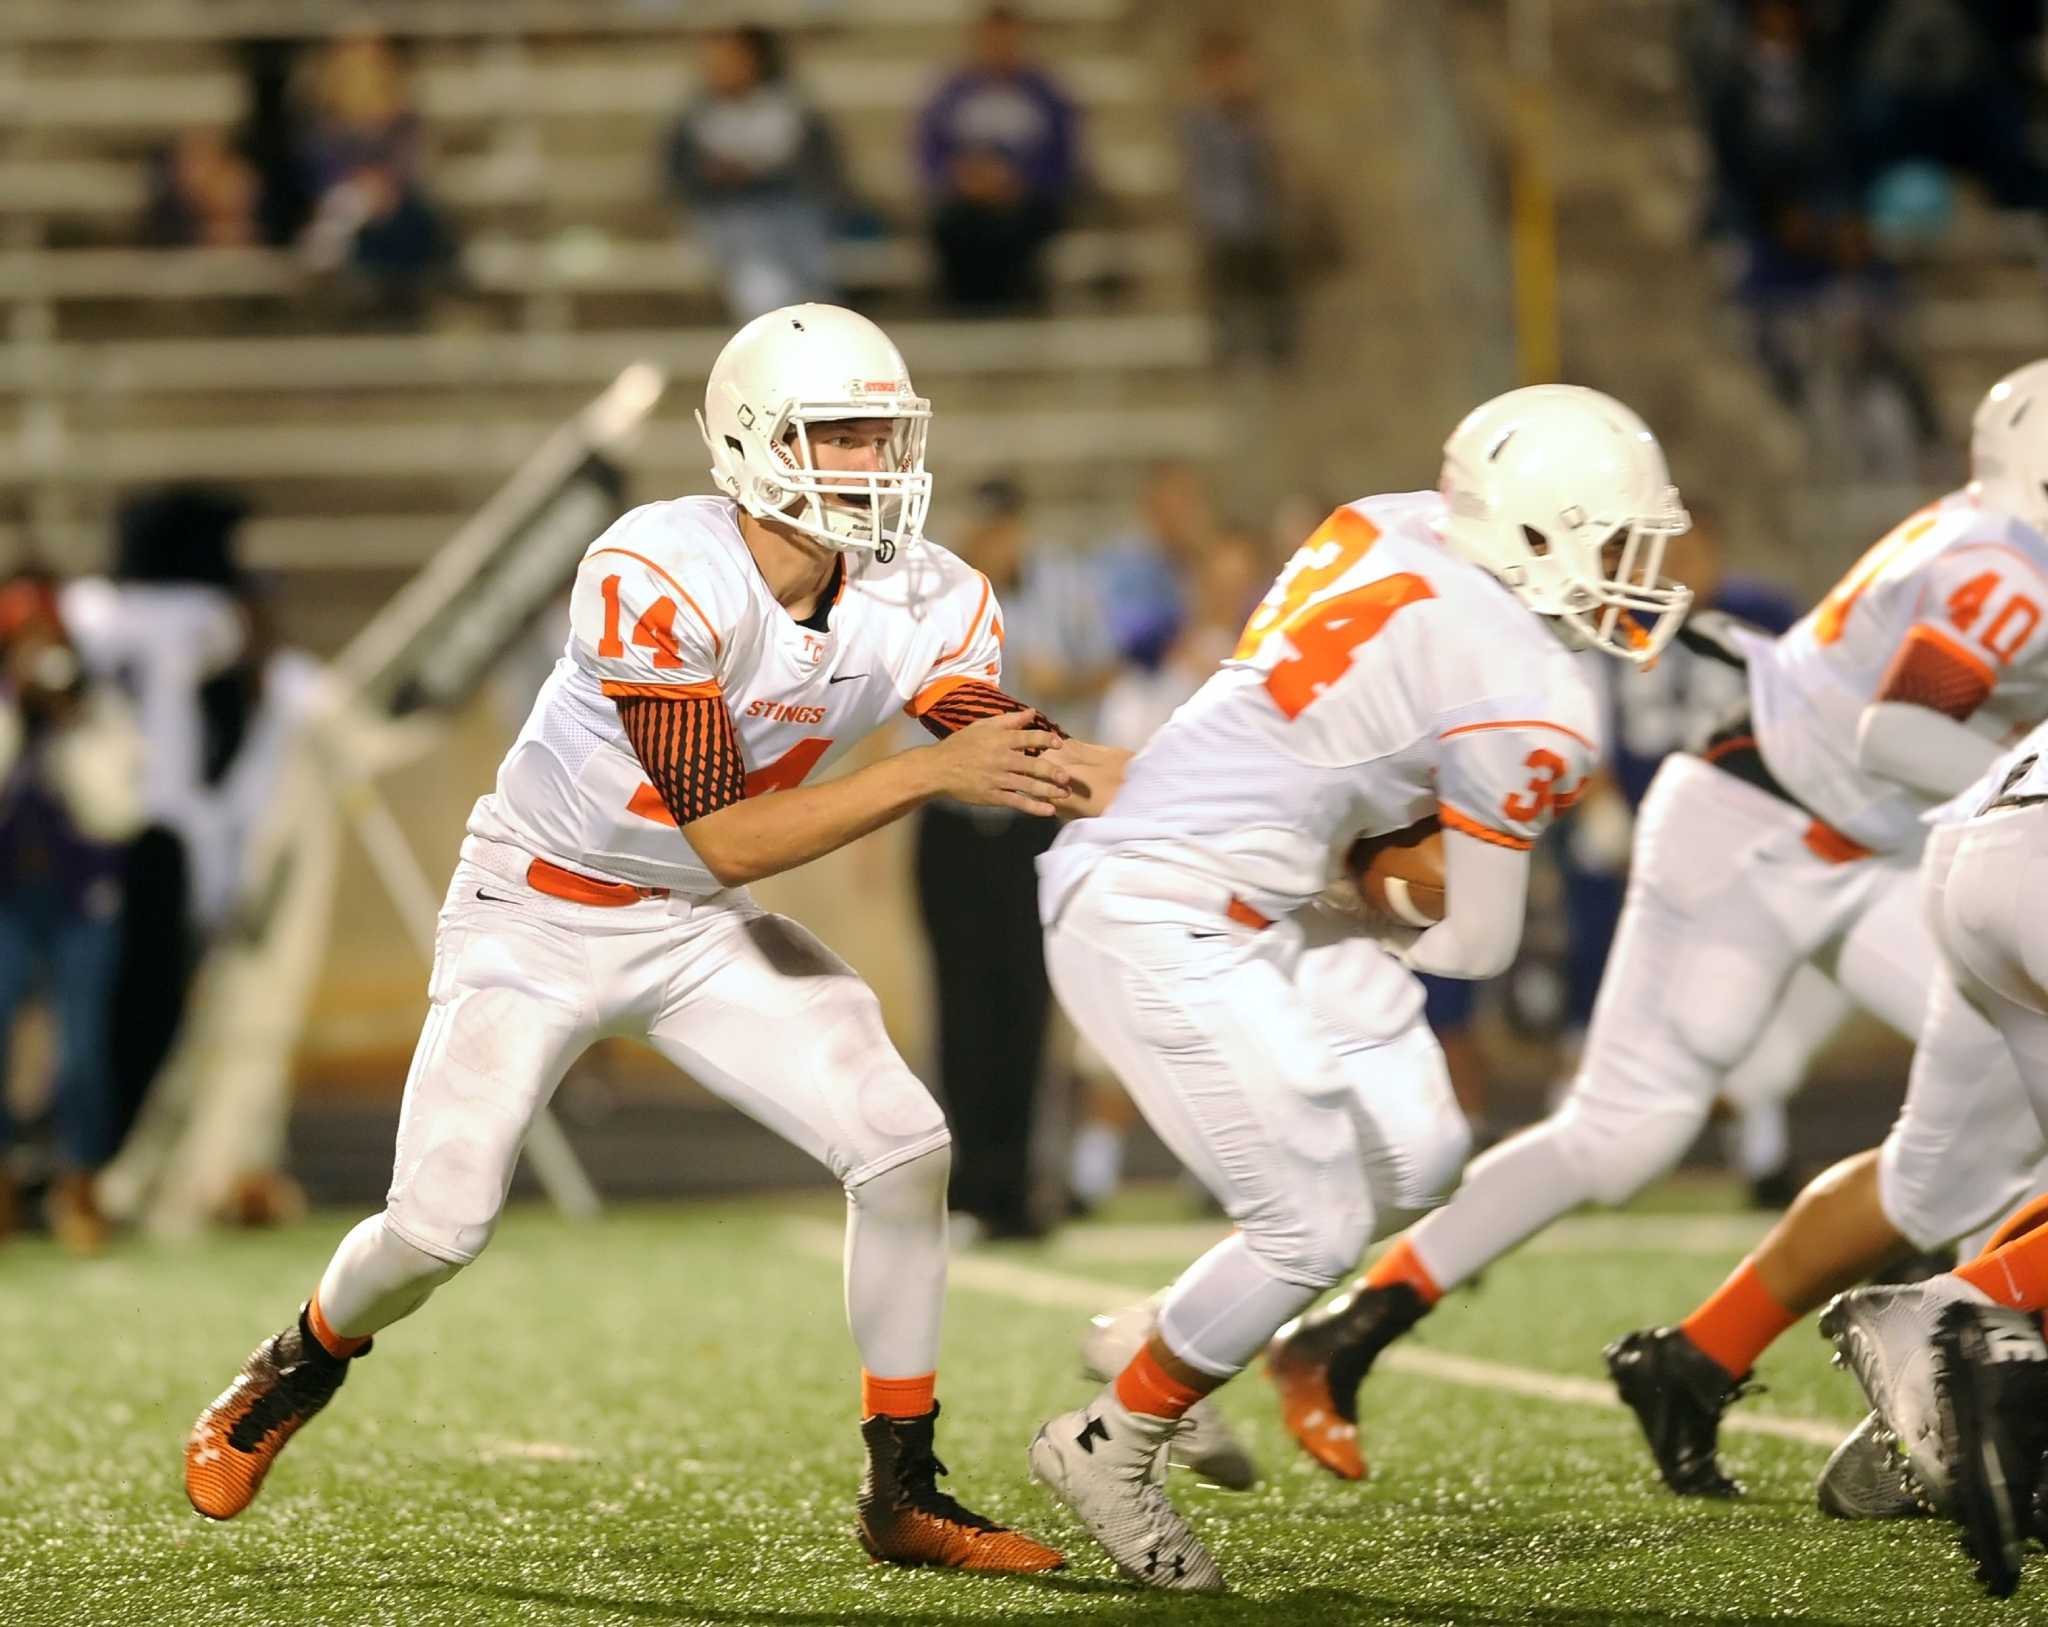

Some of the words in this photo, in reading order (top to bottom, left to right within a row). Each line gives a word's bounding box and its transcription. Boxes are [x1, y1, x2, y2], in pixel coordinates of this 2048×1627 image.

[598, 574, 684, 670] 14
[1946, 570, 2041, 667] 40
[746, 700, 827, 724] STINGS
